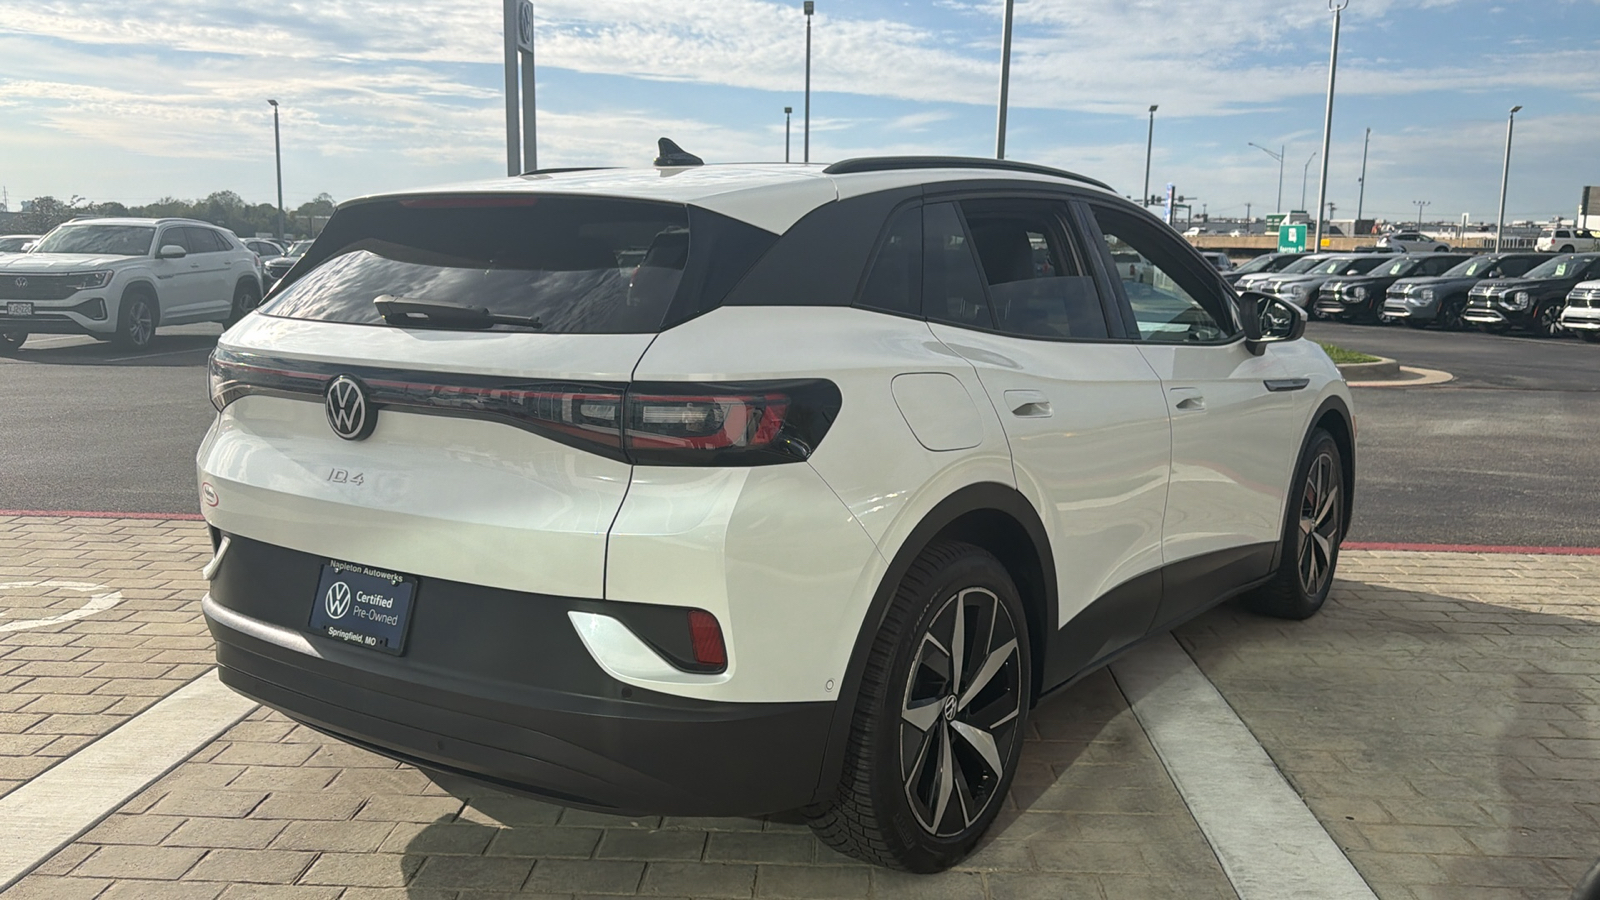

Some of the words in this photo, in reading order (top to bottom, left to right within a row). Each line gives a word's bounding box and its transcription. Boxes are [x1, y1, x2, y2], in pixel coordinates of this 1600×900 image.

[326, 378, 366, 439] VW
[330, 560, 362, 573] Napleton
[363, 567, 403, 582] Autowerks
[325, 581, 351, 619] VW
[356, 591, 393, 608] Certified
[353, 605, 398, 626] Pre-Owned
[328, 626, 363, 643] Springfield,
[364, 635, 377, 646] MO
